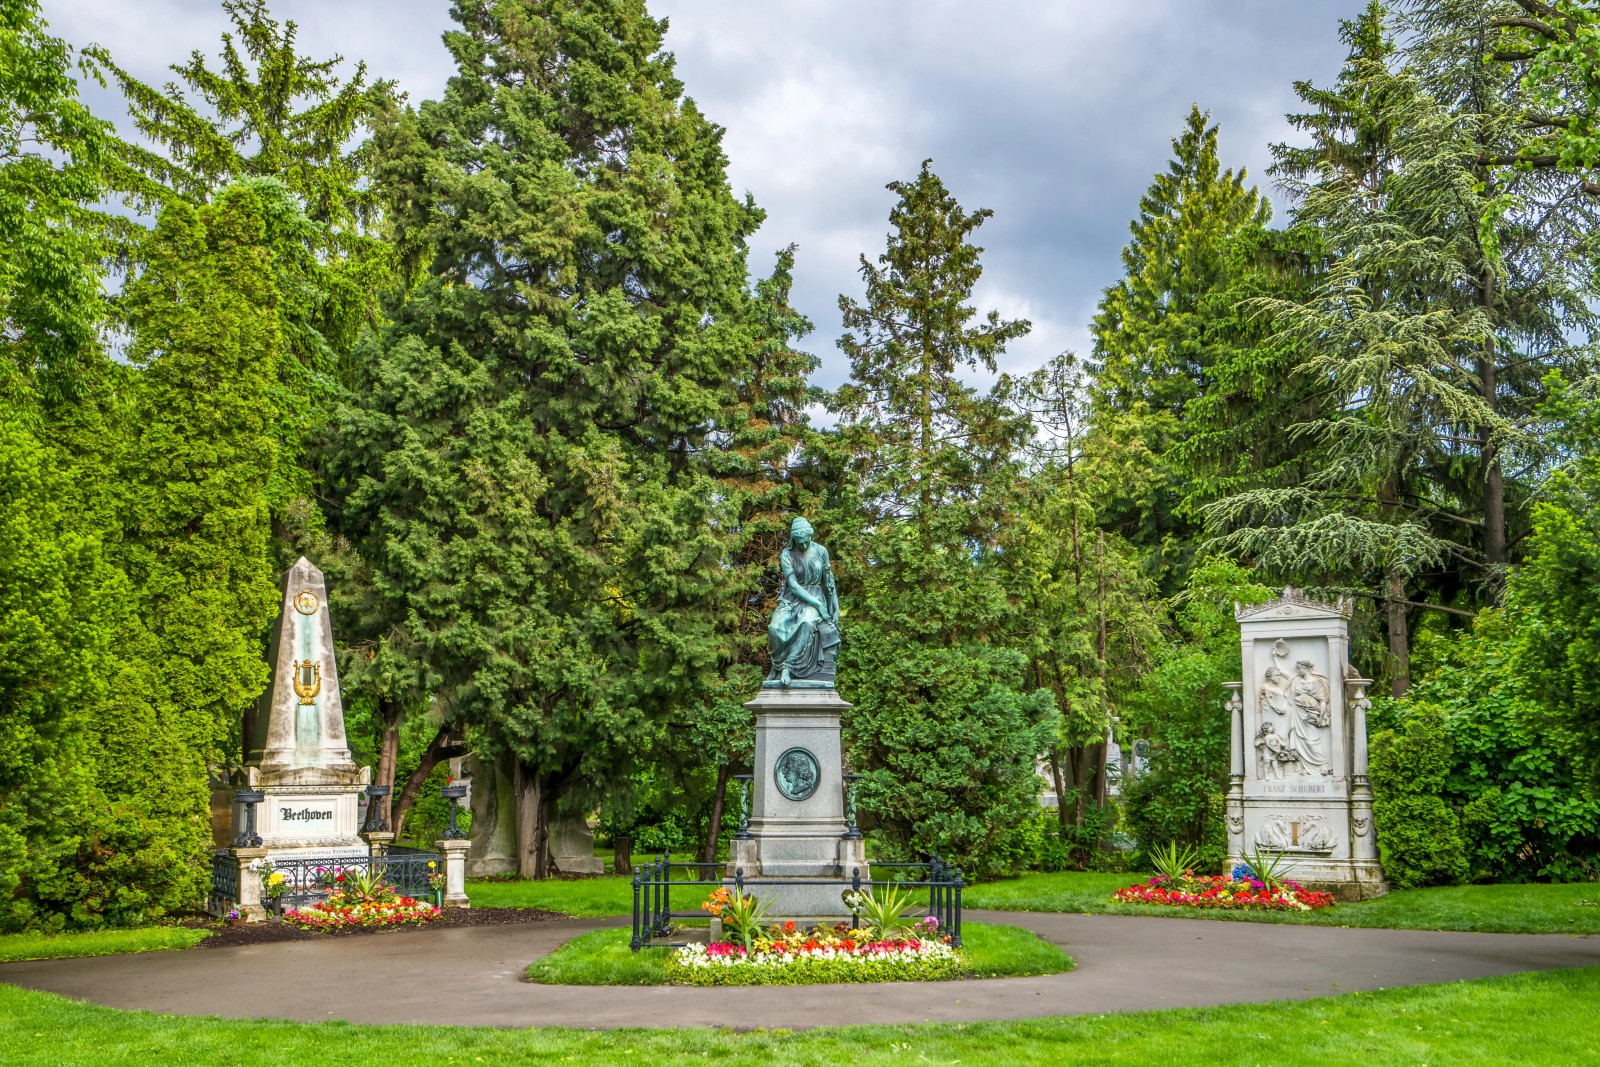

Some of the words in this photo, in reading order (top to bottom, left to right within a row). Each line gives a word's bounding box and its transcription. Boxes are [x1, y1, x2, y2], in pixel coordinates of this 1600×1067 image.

[1263, 785, 1286, 793] FRANZ
[1289, 785, 1325, 793] SCHUBERT
[280, 807, 332, 822] Beethoven
